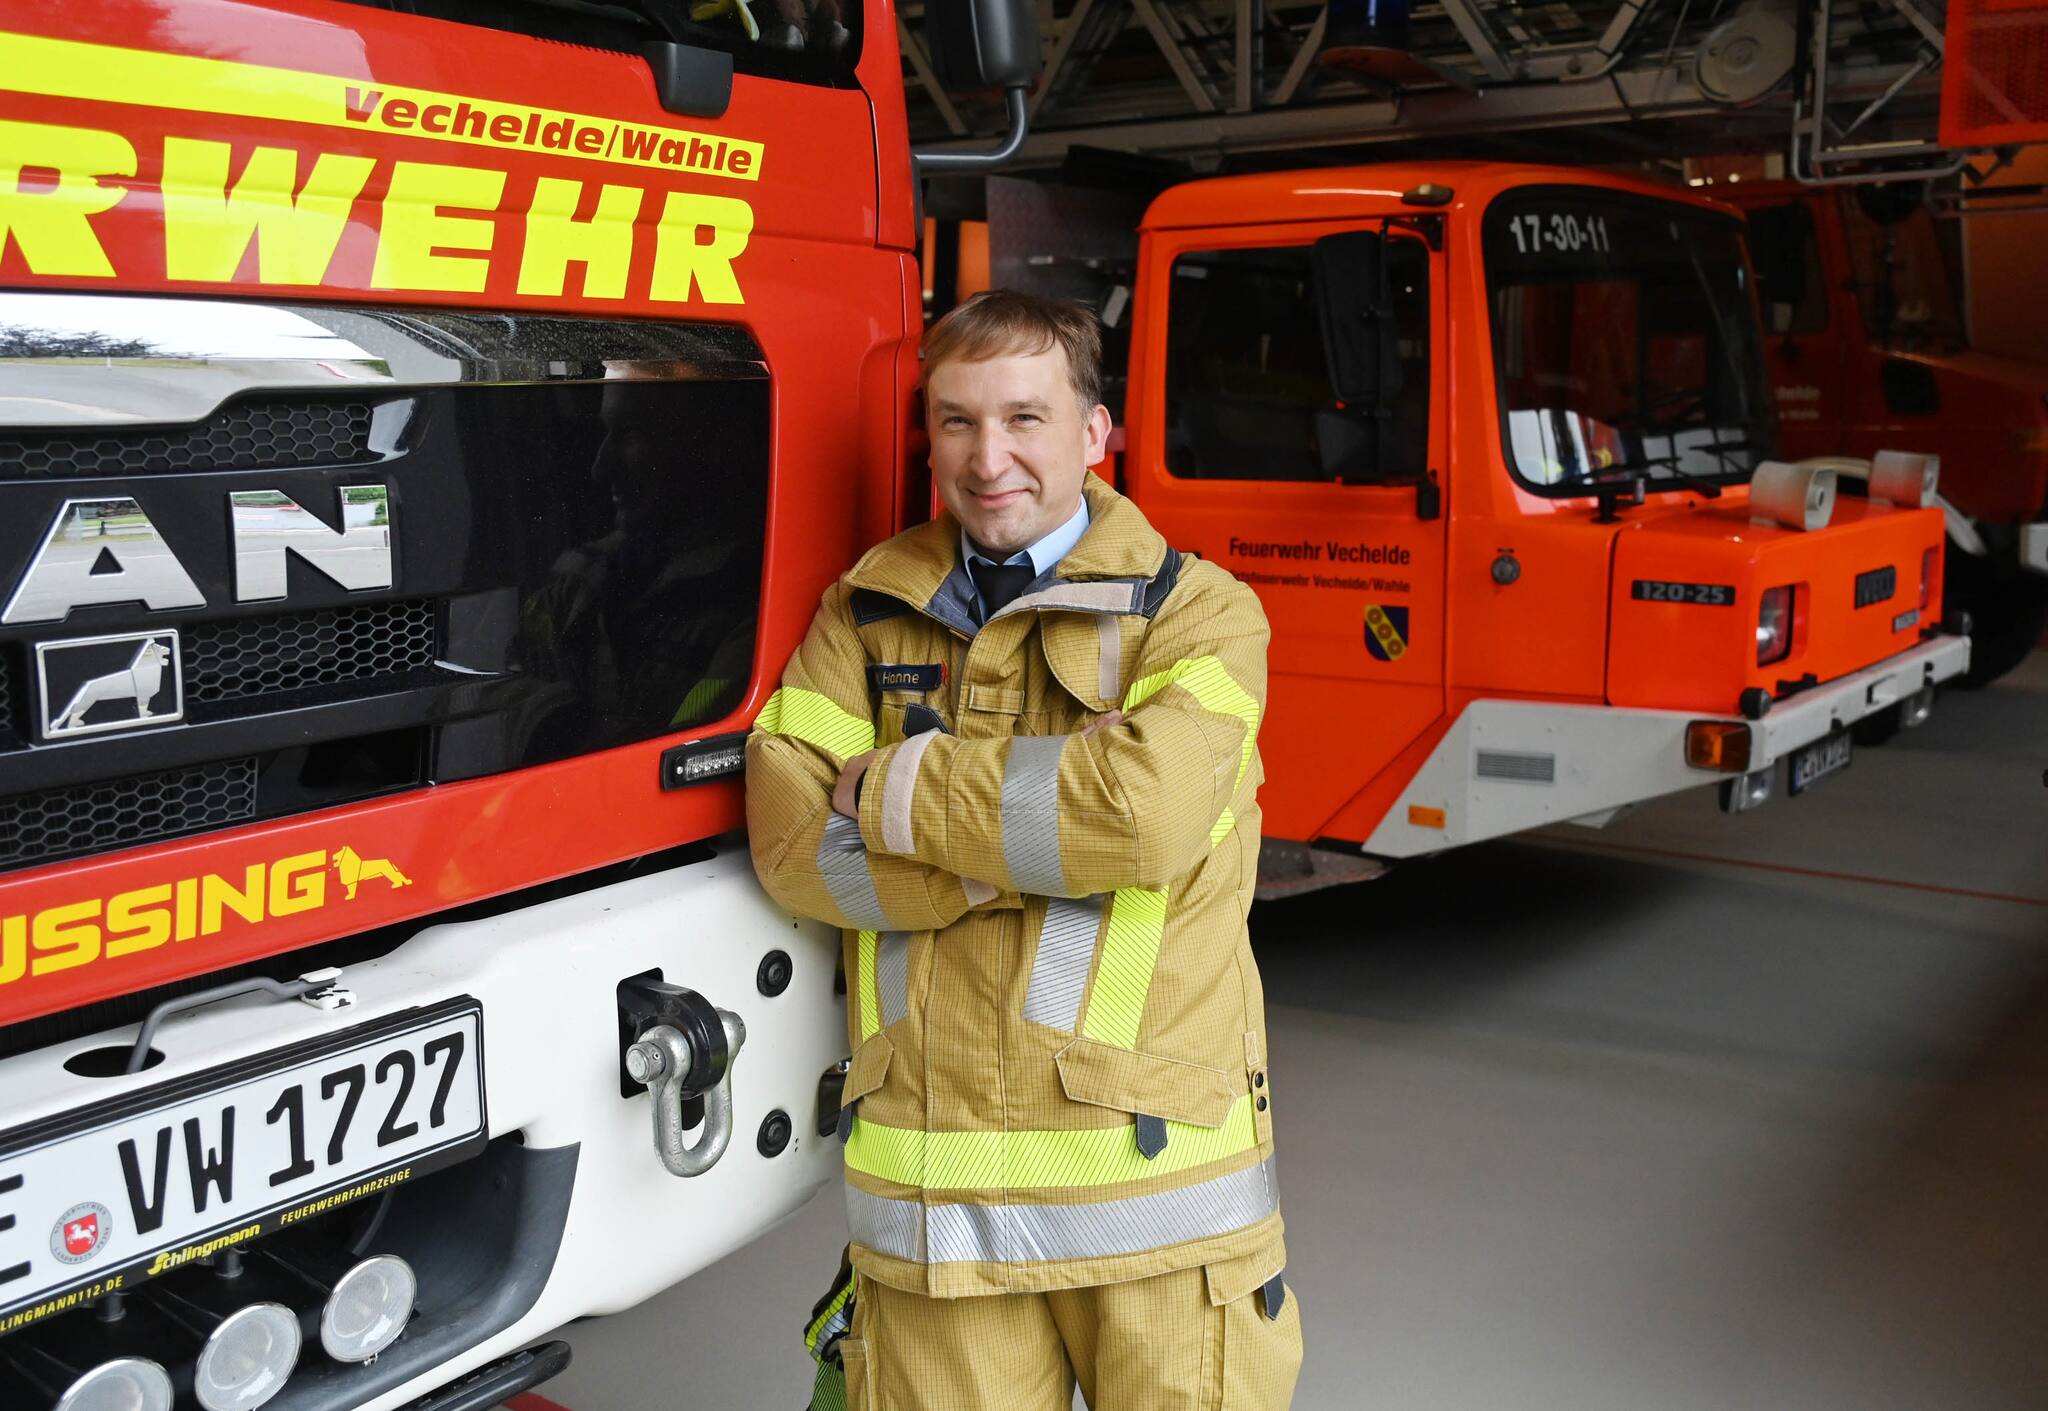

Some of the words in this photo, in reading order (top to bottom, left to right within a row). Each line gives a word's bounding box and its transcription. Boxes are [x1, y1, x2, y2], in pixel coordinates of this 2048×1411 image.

[345, 86, 753, 175] Vechelde/Wahle
[0, 119, 754, 305] RWEHR
[1510, 213, 1610, 253] 17-30-11
[2, 484, 395, 624] AN
[1229, 537, 1321, 561] Feuerwehr
[1326, 541, 1411, 565] Vechelde
[1641, 581, 1725, 605] 120-25
[117, 1105, 236, 1235] VW
[266, 1031, 465, 1187] 1727
[147, 1223, 261, 1276] Schlingmann
[280, 1168, 411, 1226] FEUERWEHRFAHRZEUGE
